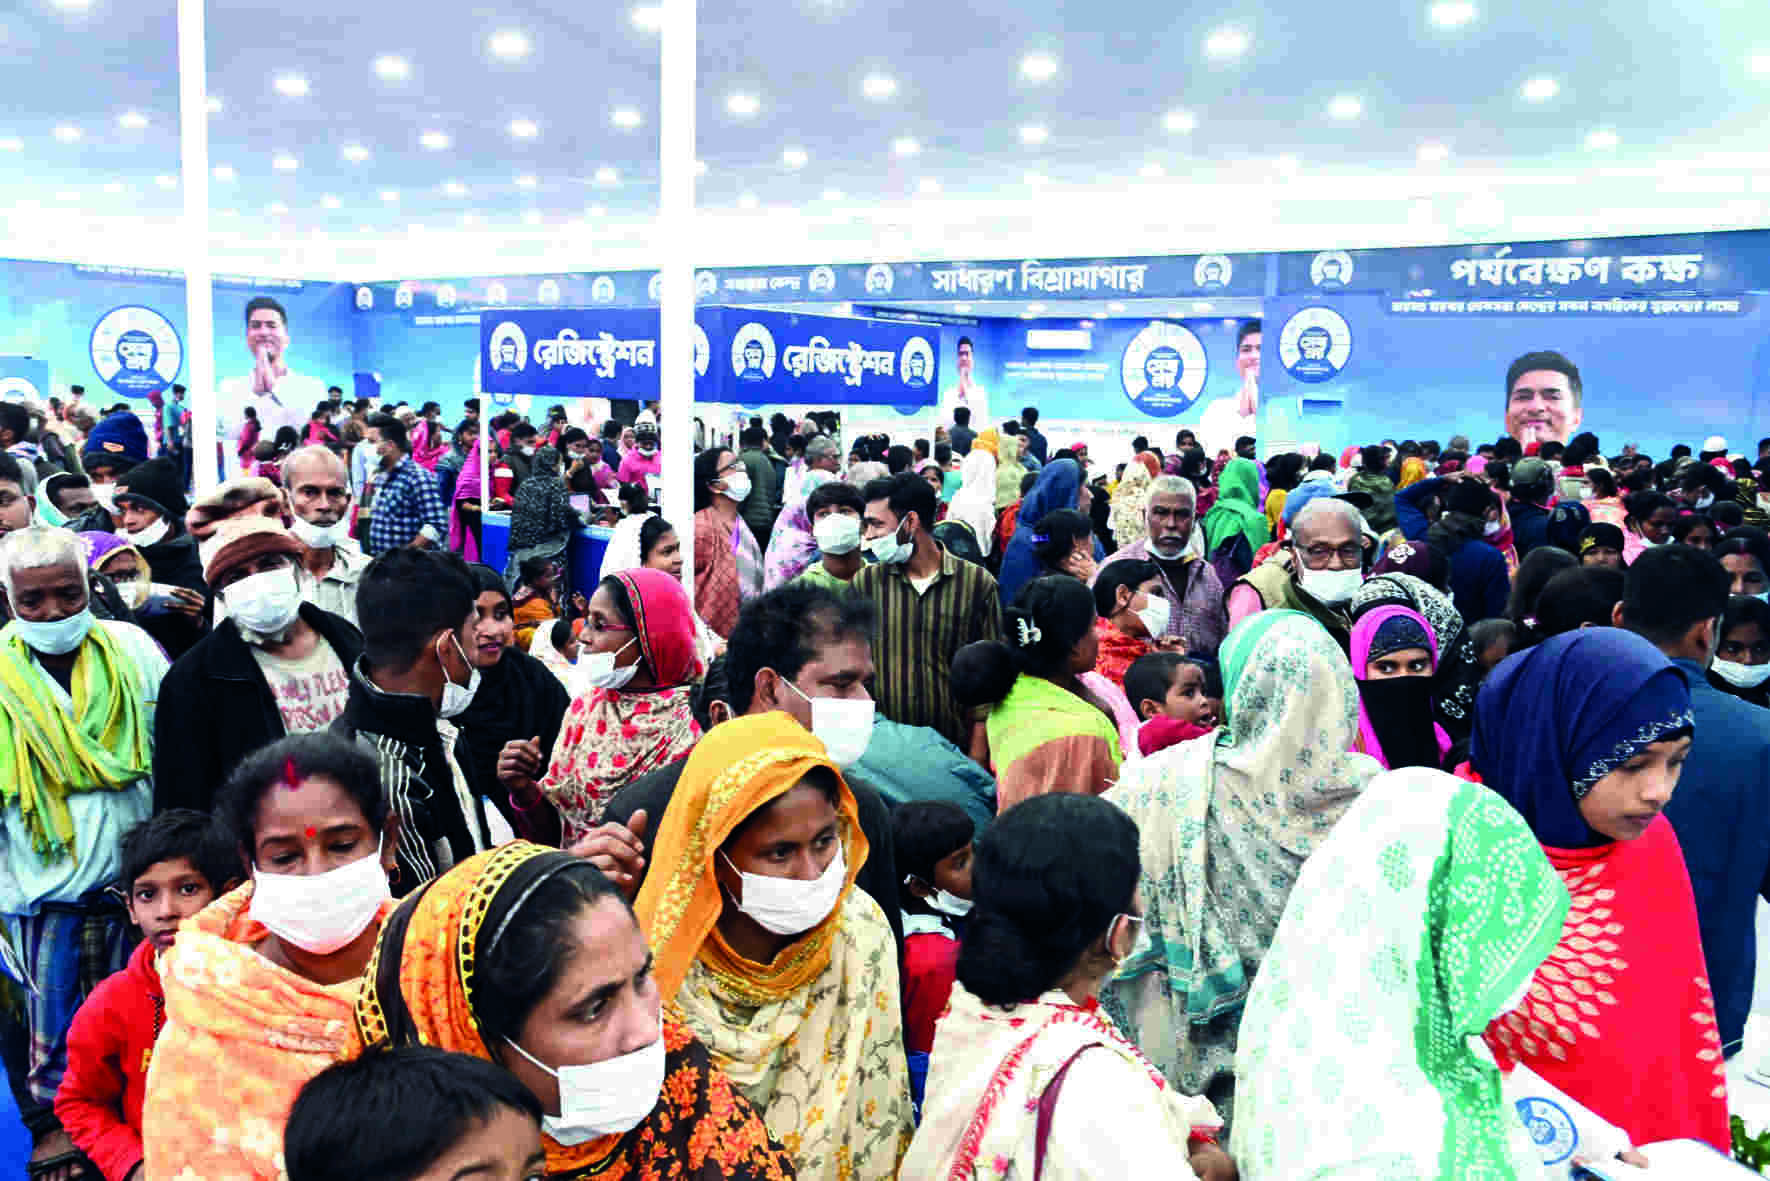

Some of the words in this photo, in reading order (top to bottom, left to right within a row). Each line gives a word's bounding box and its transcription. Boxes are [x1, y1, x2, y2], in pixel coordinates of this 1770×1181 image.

[1019, 259, 1147, 293] বিশ্রামাগার
[1449, 246, 1613, 287] পর্যবেক্ষণ
[1620, 253, 1703, 283] কক্ষ
[533, 328, 656, 379] রেজিস্ট্রেশন
[782, 335, 895, 387] রেজিস্ট্রেশন
